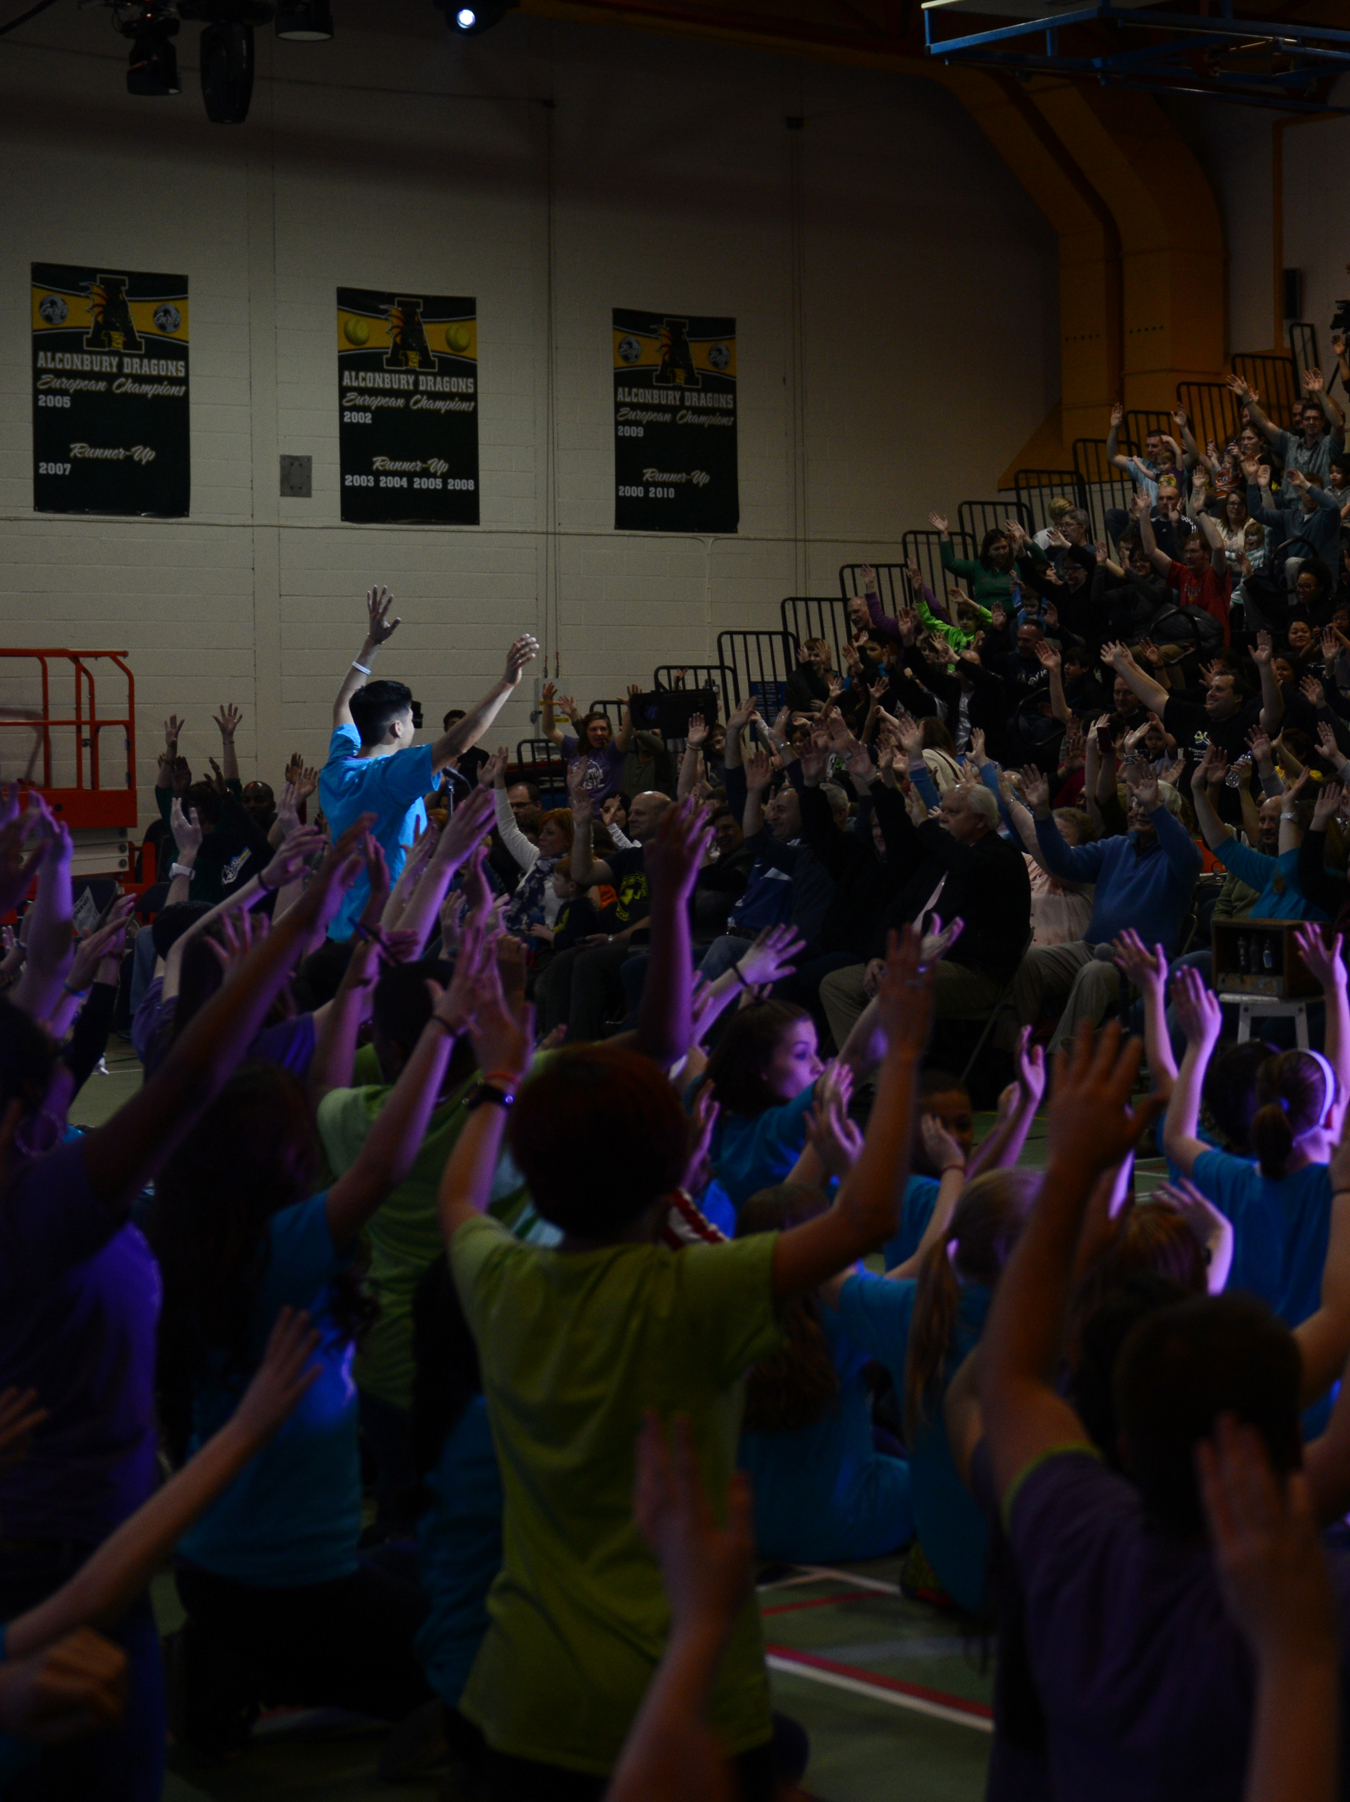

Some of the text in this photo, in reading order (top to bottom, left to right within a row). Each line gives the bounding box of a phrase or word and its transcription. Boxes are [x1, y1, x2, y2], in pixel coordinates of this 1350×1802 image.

[37, 351, 186, 377] ALCONBURY DRAGONS
[36, 373, 187, 399] European Champions
[342, 370, 475, 394] ALCONBURY DRAGONS
[38, 394, 71, 408] 2005
[342, 391, 477, 415] European Champions
[617, 387, 734, 409] ALCONBURY DRAGONS
[343, 411, 372, 424] 2002
[616, 406, 735, 428] European Champions
[617, 425, 644, 437] 2009
[69, 442, 156, 466] Runner-Up
[39, 462, 71, 475] 2007
[371, 455, 450, 477] Runner-Up
[642, 467, 711, 487] Runner-Up
[344, 474, 475, 491] 2003 2004 2005 2008
[618, 485, 675, 499] 2000 2010
